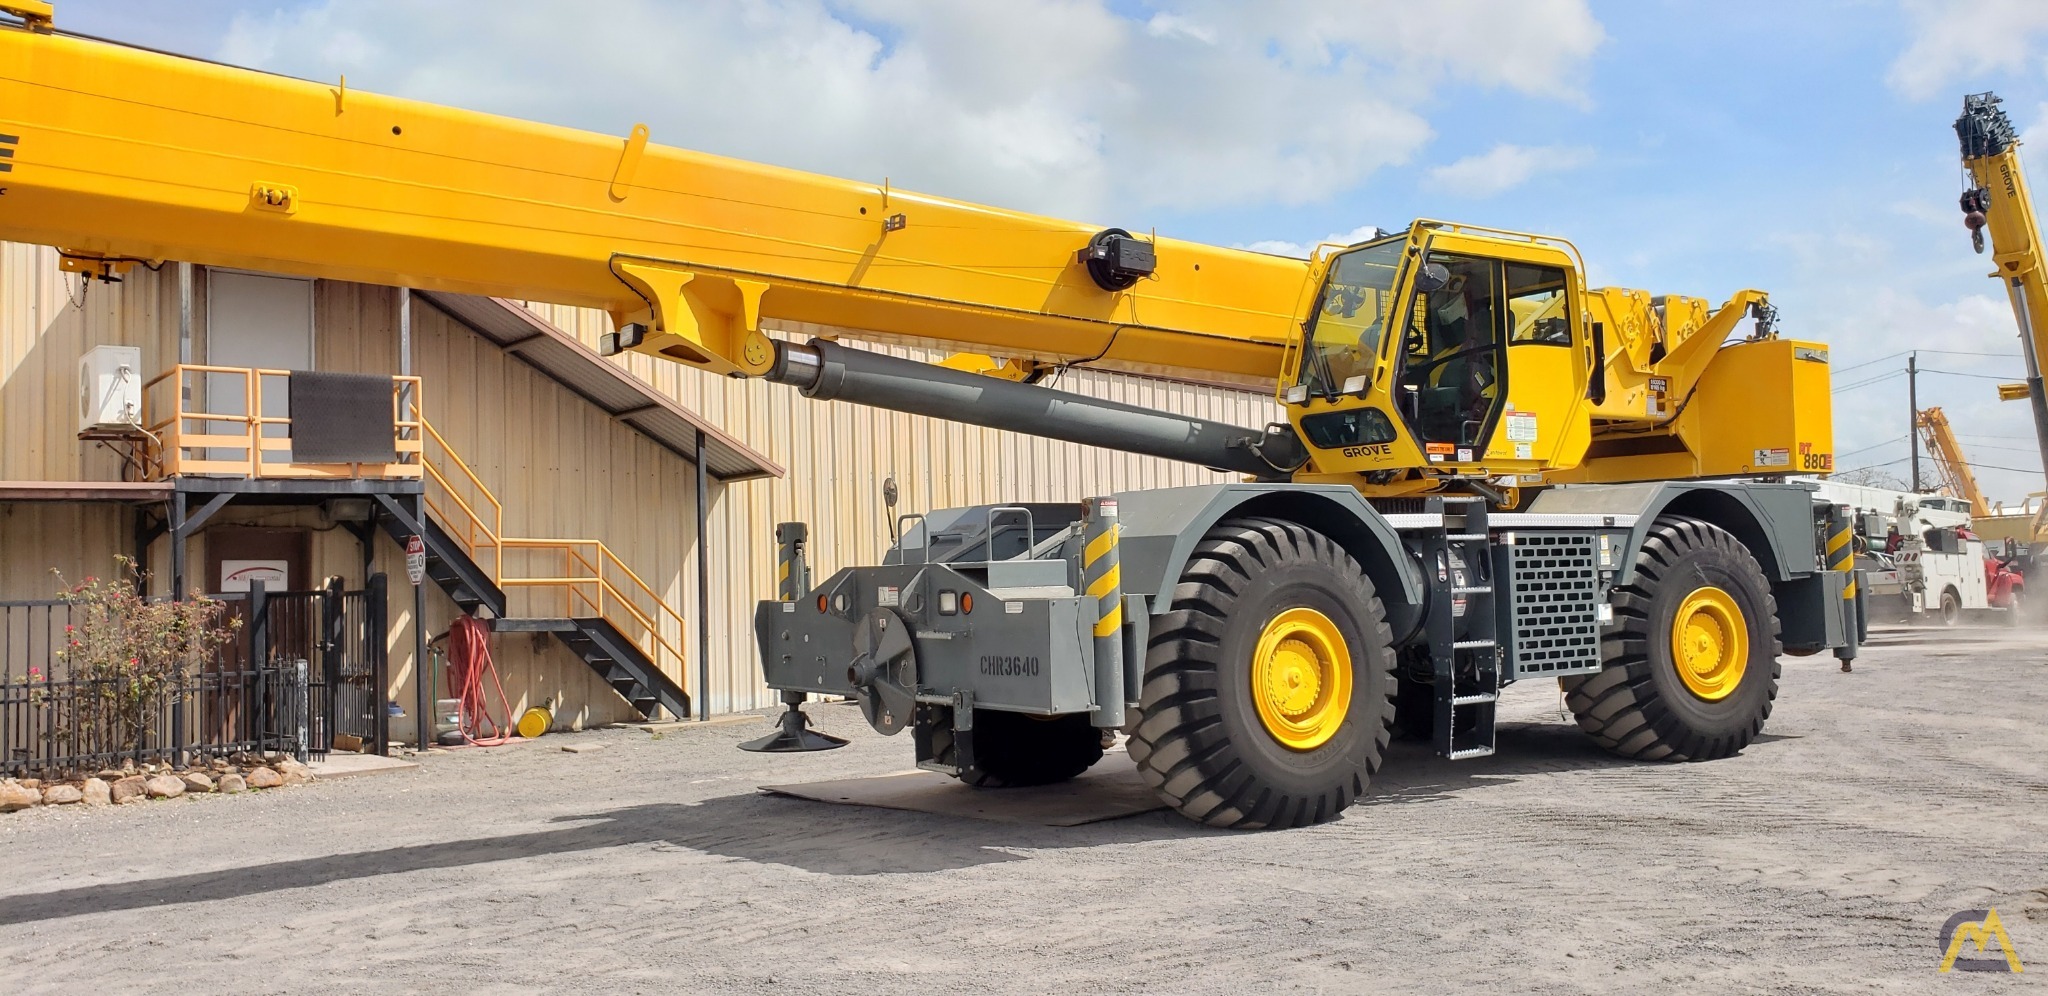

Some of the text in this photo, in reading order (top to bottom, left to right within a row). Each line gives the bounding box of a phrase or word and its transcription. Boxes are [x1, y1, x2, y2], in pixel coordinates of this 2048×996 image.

[2000, 164, 2017, 199] GROVE
[1342, 444, 1392, 458] GROVE
[1799, 442, 1812, 455] RT
[1804, 454, 1832, 469] 880E
[980, 655, 1040, 677] CHR3640
